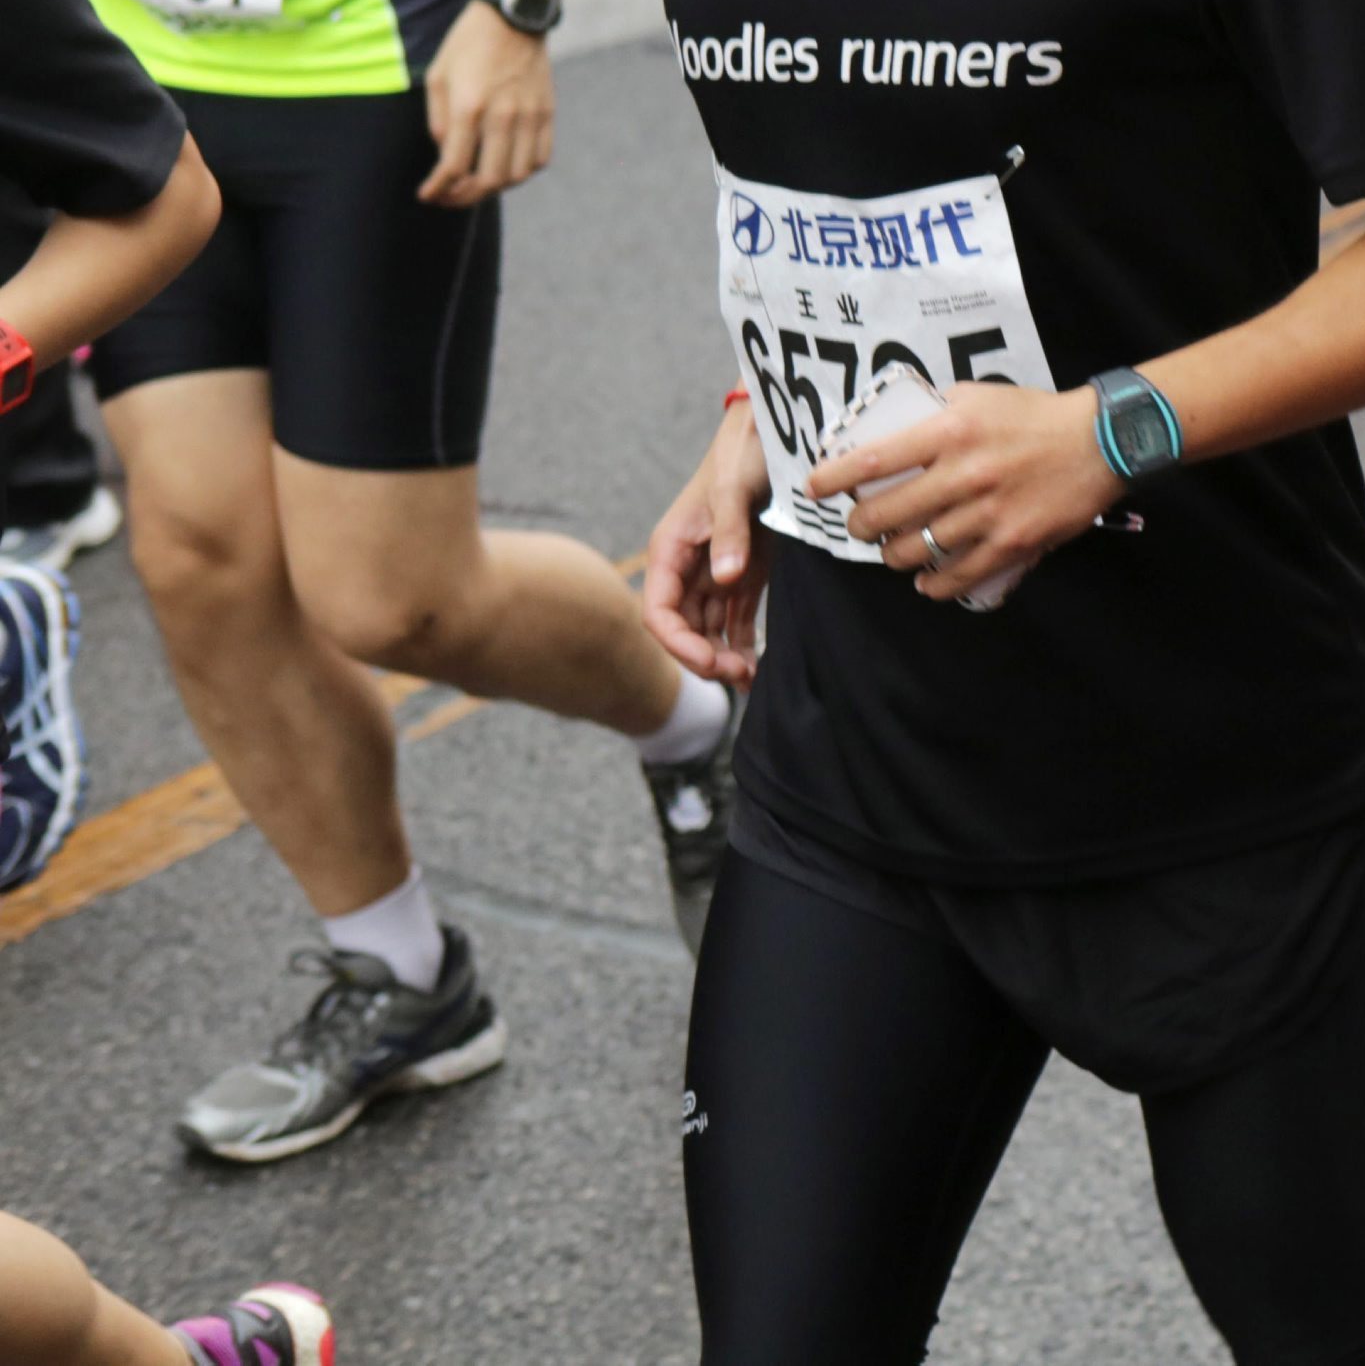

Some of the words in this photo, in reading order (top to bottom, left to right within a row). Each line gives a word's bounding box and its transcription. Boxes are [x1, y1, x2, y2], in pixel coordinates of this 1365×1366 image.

[840, 37, 1063, 88] runners
[781, 200, 982, 269] 北京现代
